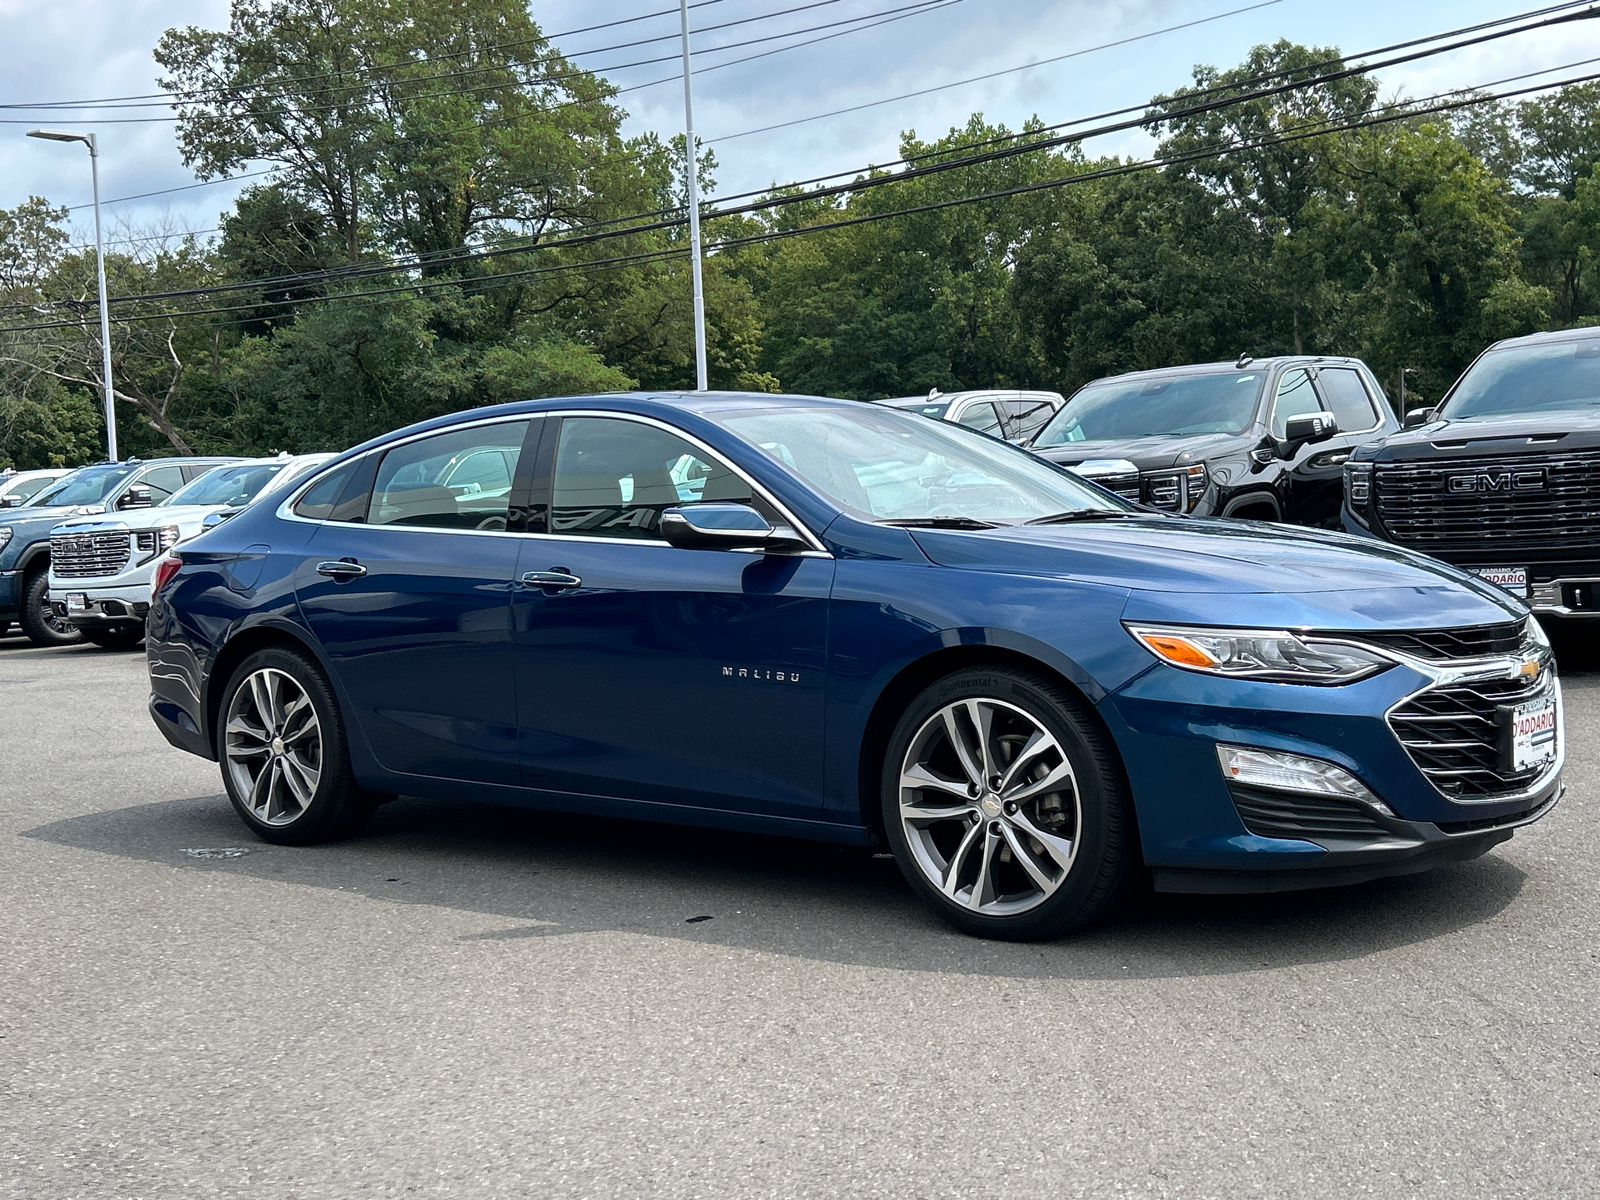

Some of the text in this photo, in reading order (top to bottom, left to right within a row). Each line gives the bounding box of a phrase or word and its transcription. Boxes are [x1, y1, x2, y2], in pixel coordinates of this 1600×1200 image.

[1449, 471, 1543, 492] GMC
[722, 666, 800, 682] MALIBU
[938, 677, 992, 697] Continental
[1512, 712, 1554, 739] D'ADDARIO
